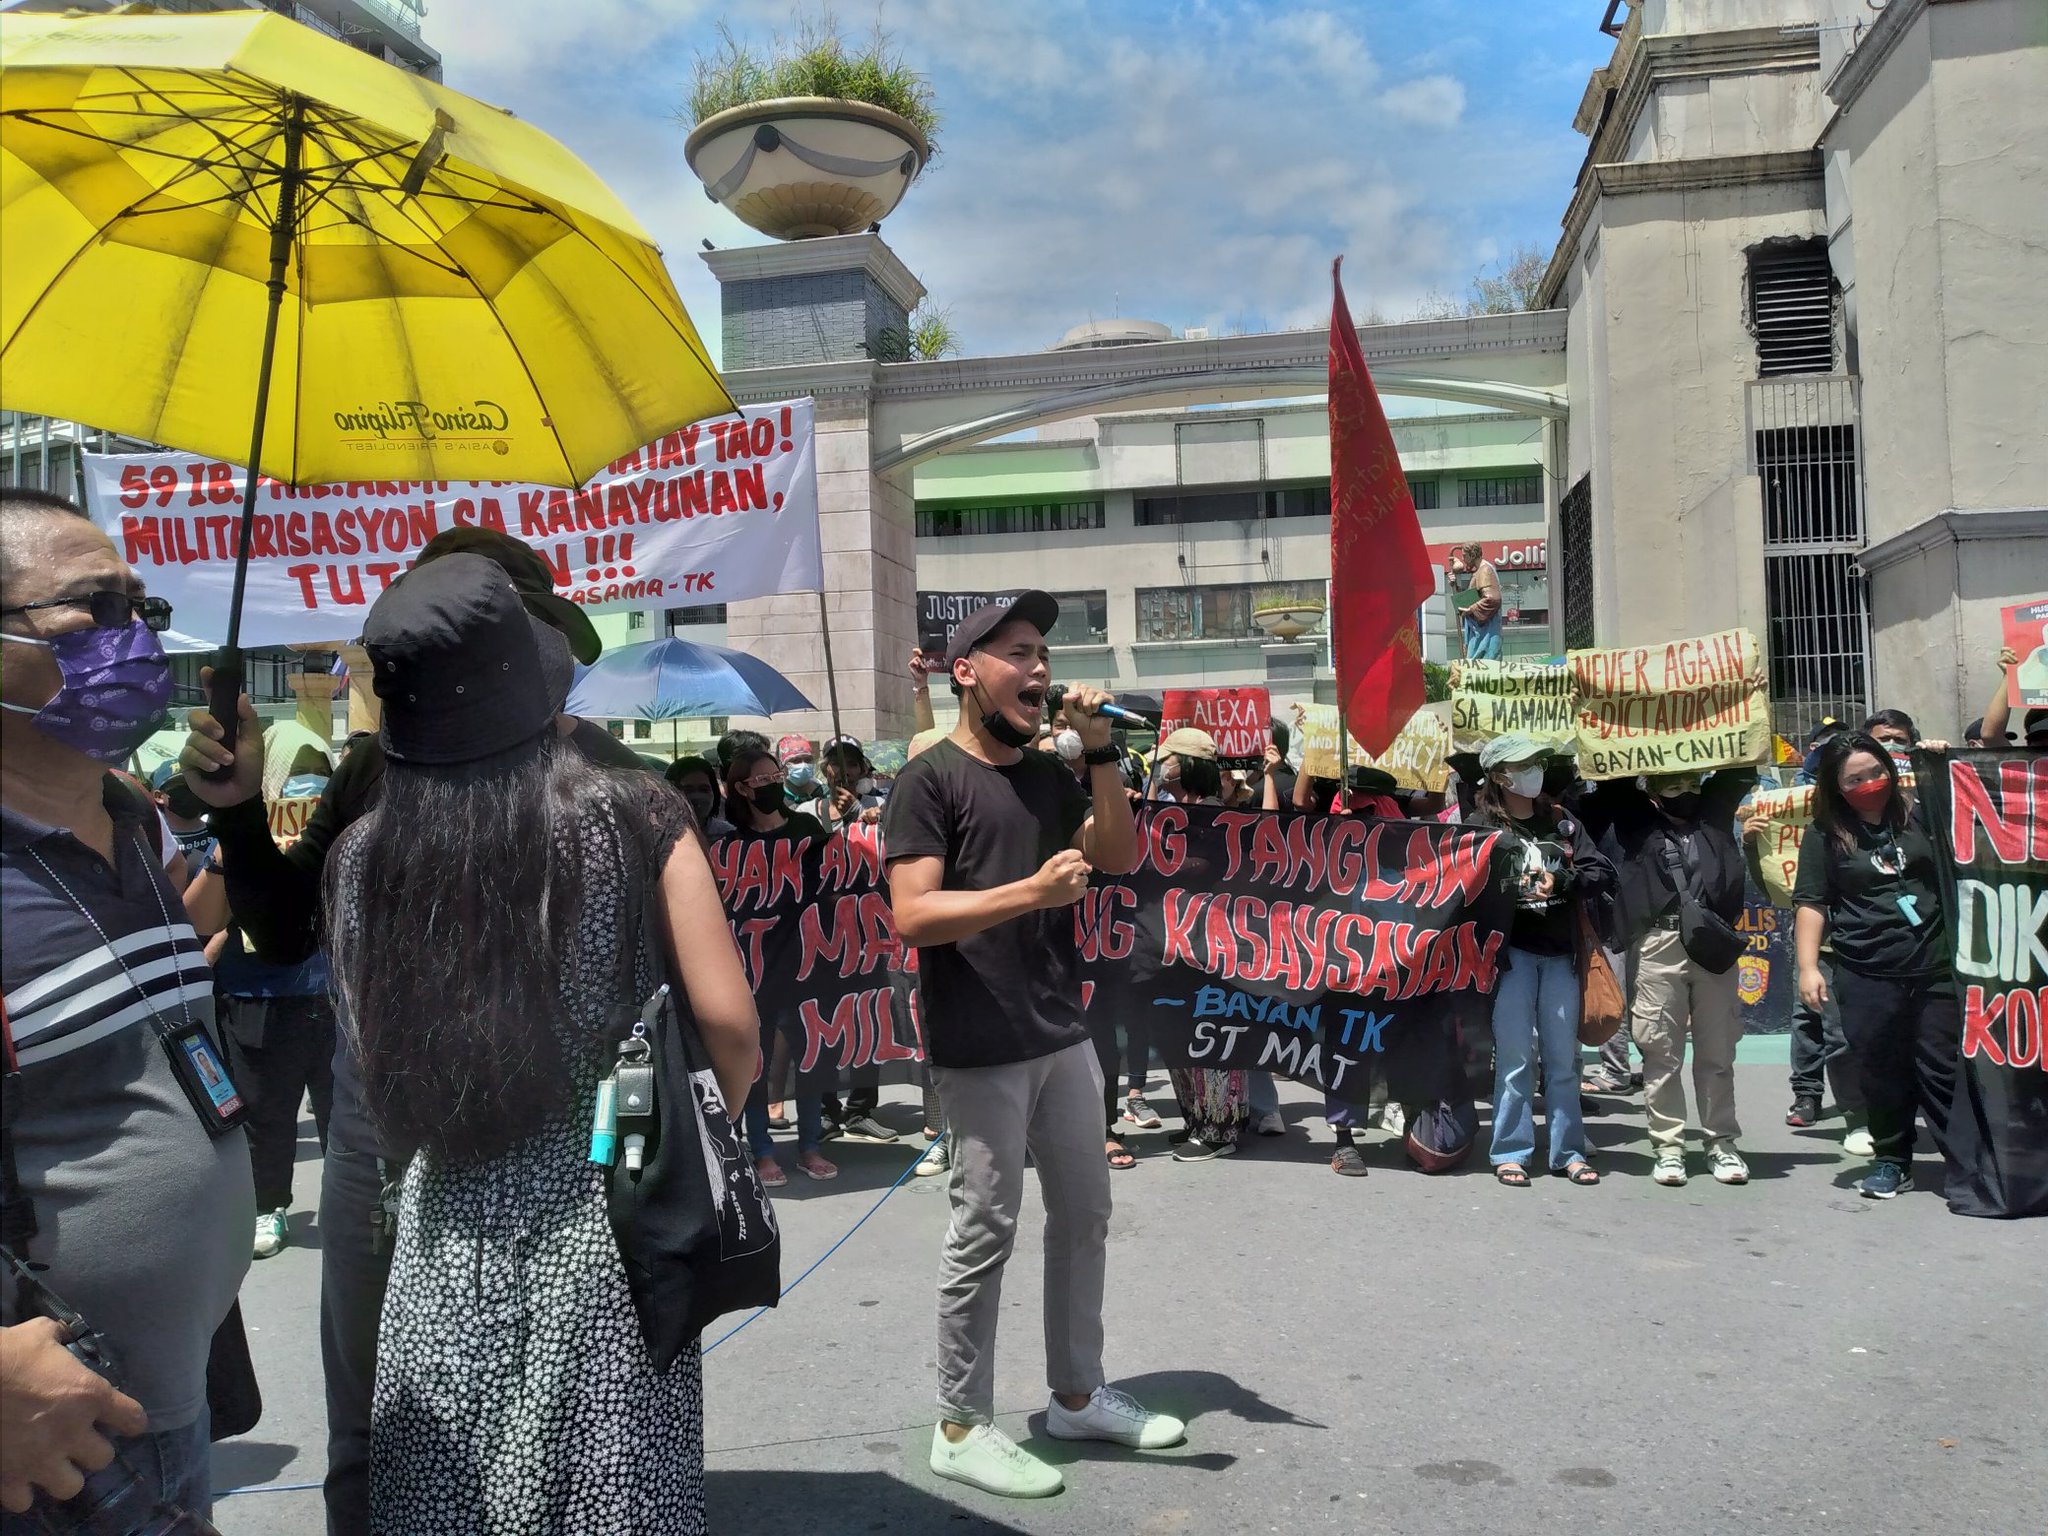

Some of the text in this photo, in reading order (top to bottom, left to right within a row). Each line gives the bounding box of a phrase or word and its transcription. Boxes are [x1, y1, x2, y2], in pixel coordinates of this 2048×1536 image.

[119, 464, 179, 509] 59
[708, 406, 795, 463] TAO!
[517, 463, 786, 538] KANAYUNAN,
[1575, 631, 1745, 700] NEVER AGAIN
[1193, 698, 1259, 727] ALEXA
[1207, 725, 1273, 756] CALDA!
[1308, 734, 1333, 750] AND
[1452, 697, 1480, 731] SA
[1578, 678, 1753, 740] TO DICTATORSHIP
[1593, 730, 1749, 774] BAYAN-CAVITE
[1211, 810, 1503, 909] TANGLAW
[1162, 888, 1505, 1001] KASAYSAYAN
[1192, 984, 1396, 1053] BAYAN TK
[1188, 1021, 1361, 1091] ST MAT
